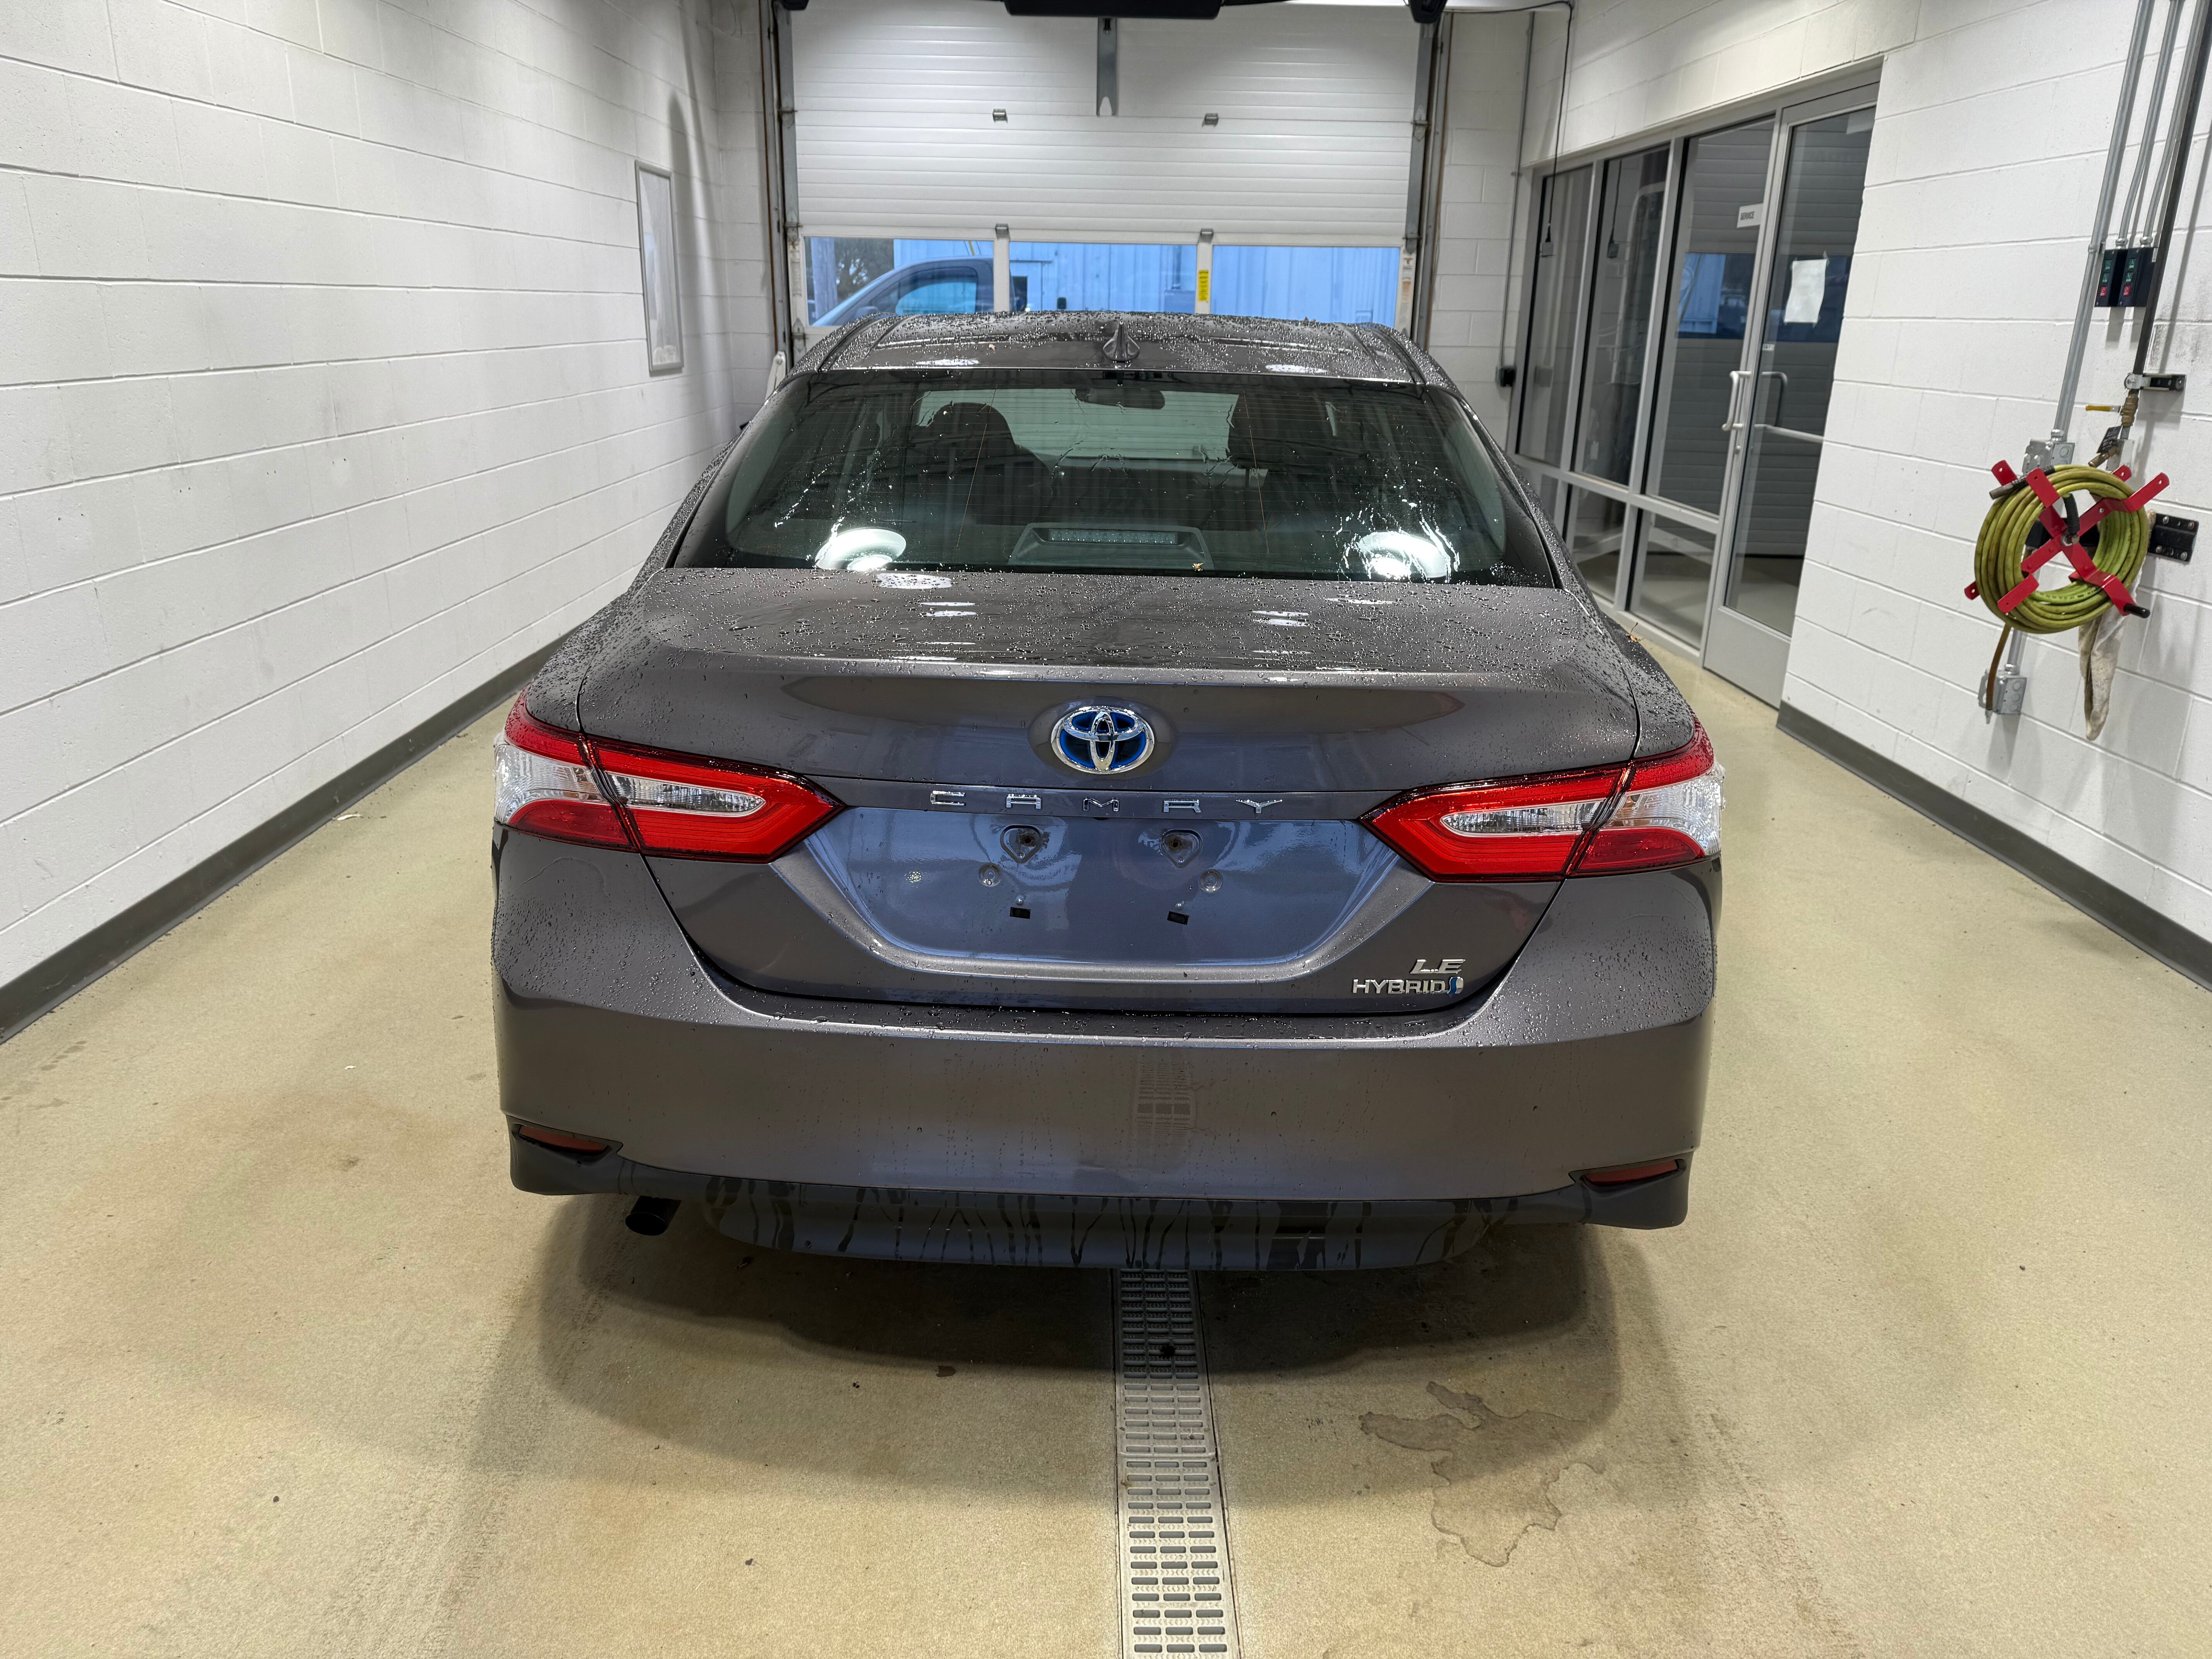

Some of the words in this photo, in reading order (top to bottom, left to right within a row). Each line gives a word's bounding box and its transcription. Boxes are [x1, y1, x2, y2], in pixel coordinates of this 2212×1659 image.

[930, 790, 1283, 813] CAMRY
[1410, 959, 1466, 974] LE
[1352, 979, 1446, 994] HYBRID
